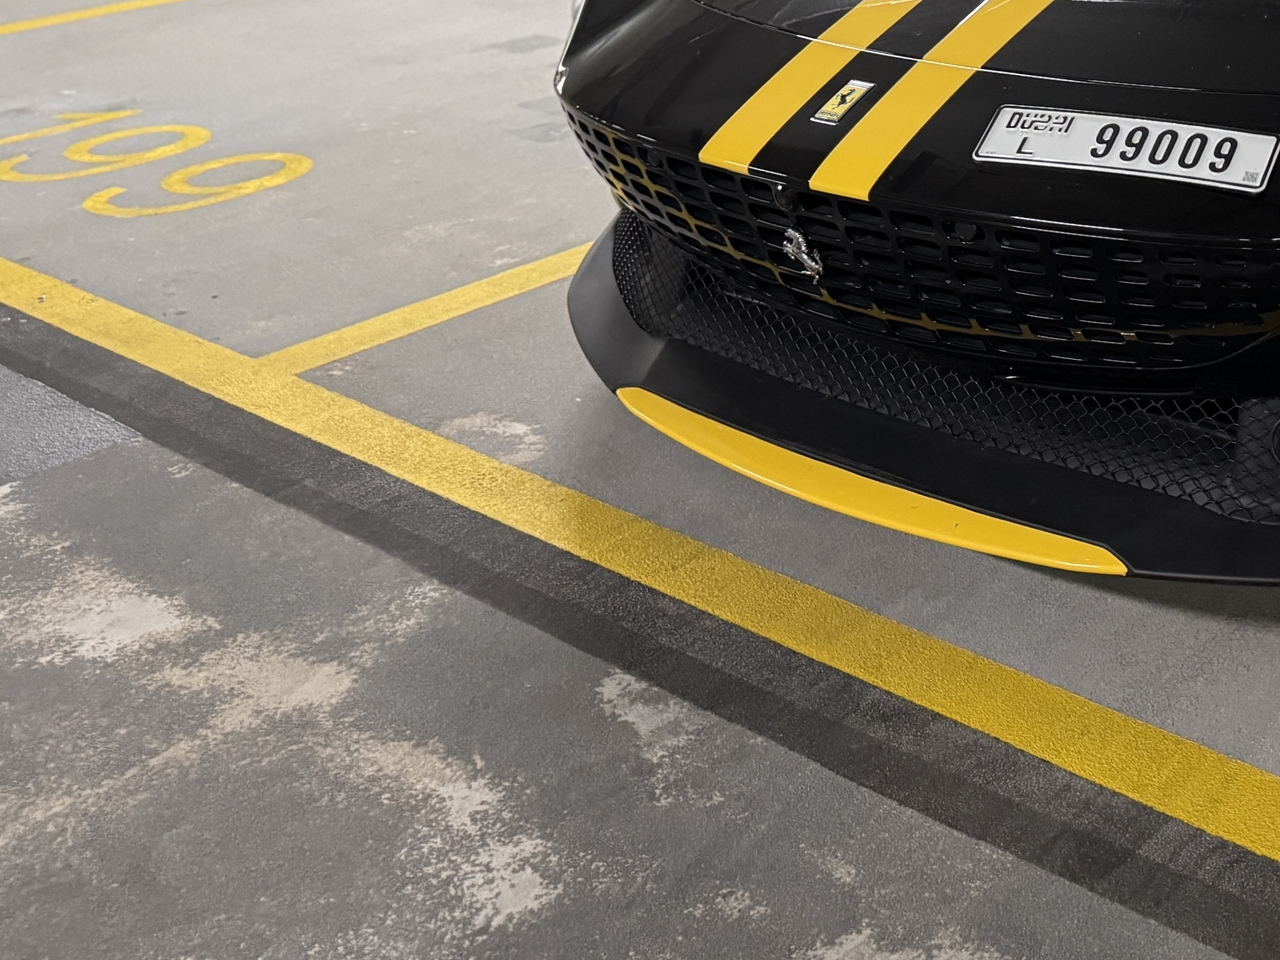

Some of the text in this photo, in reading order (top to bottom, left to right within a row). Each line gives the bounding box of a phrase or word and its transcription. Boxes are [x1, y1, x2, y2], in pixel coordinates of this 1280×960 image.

[0, 109, 315, 218] 199
[1016, 136, 1034, 155] L
[1091, 123, 1239, 173] 99009
